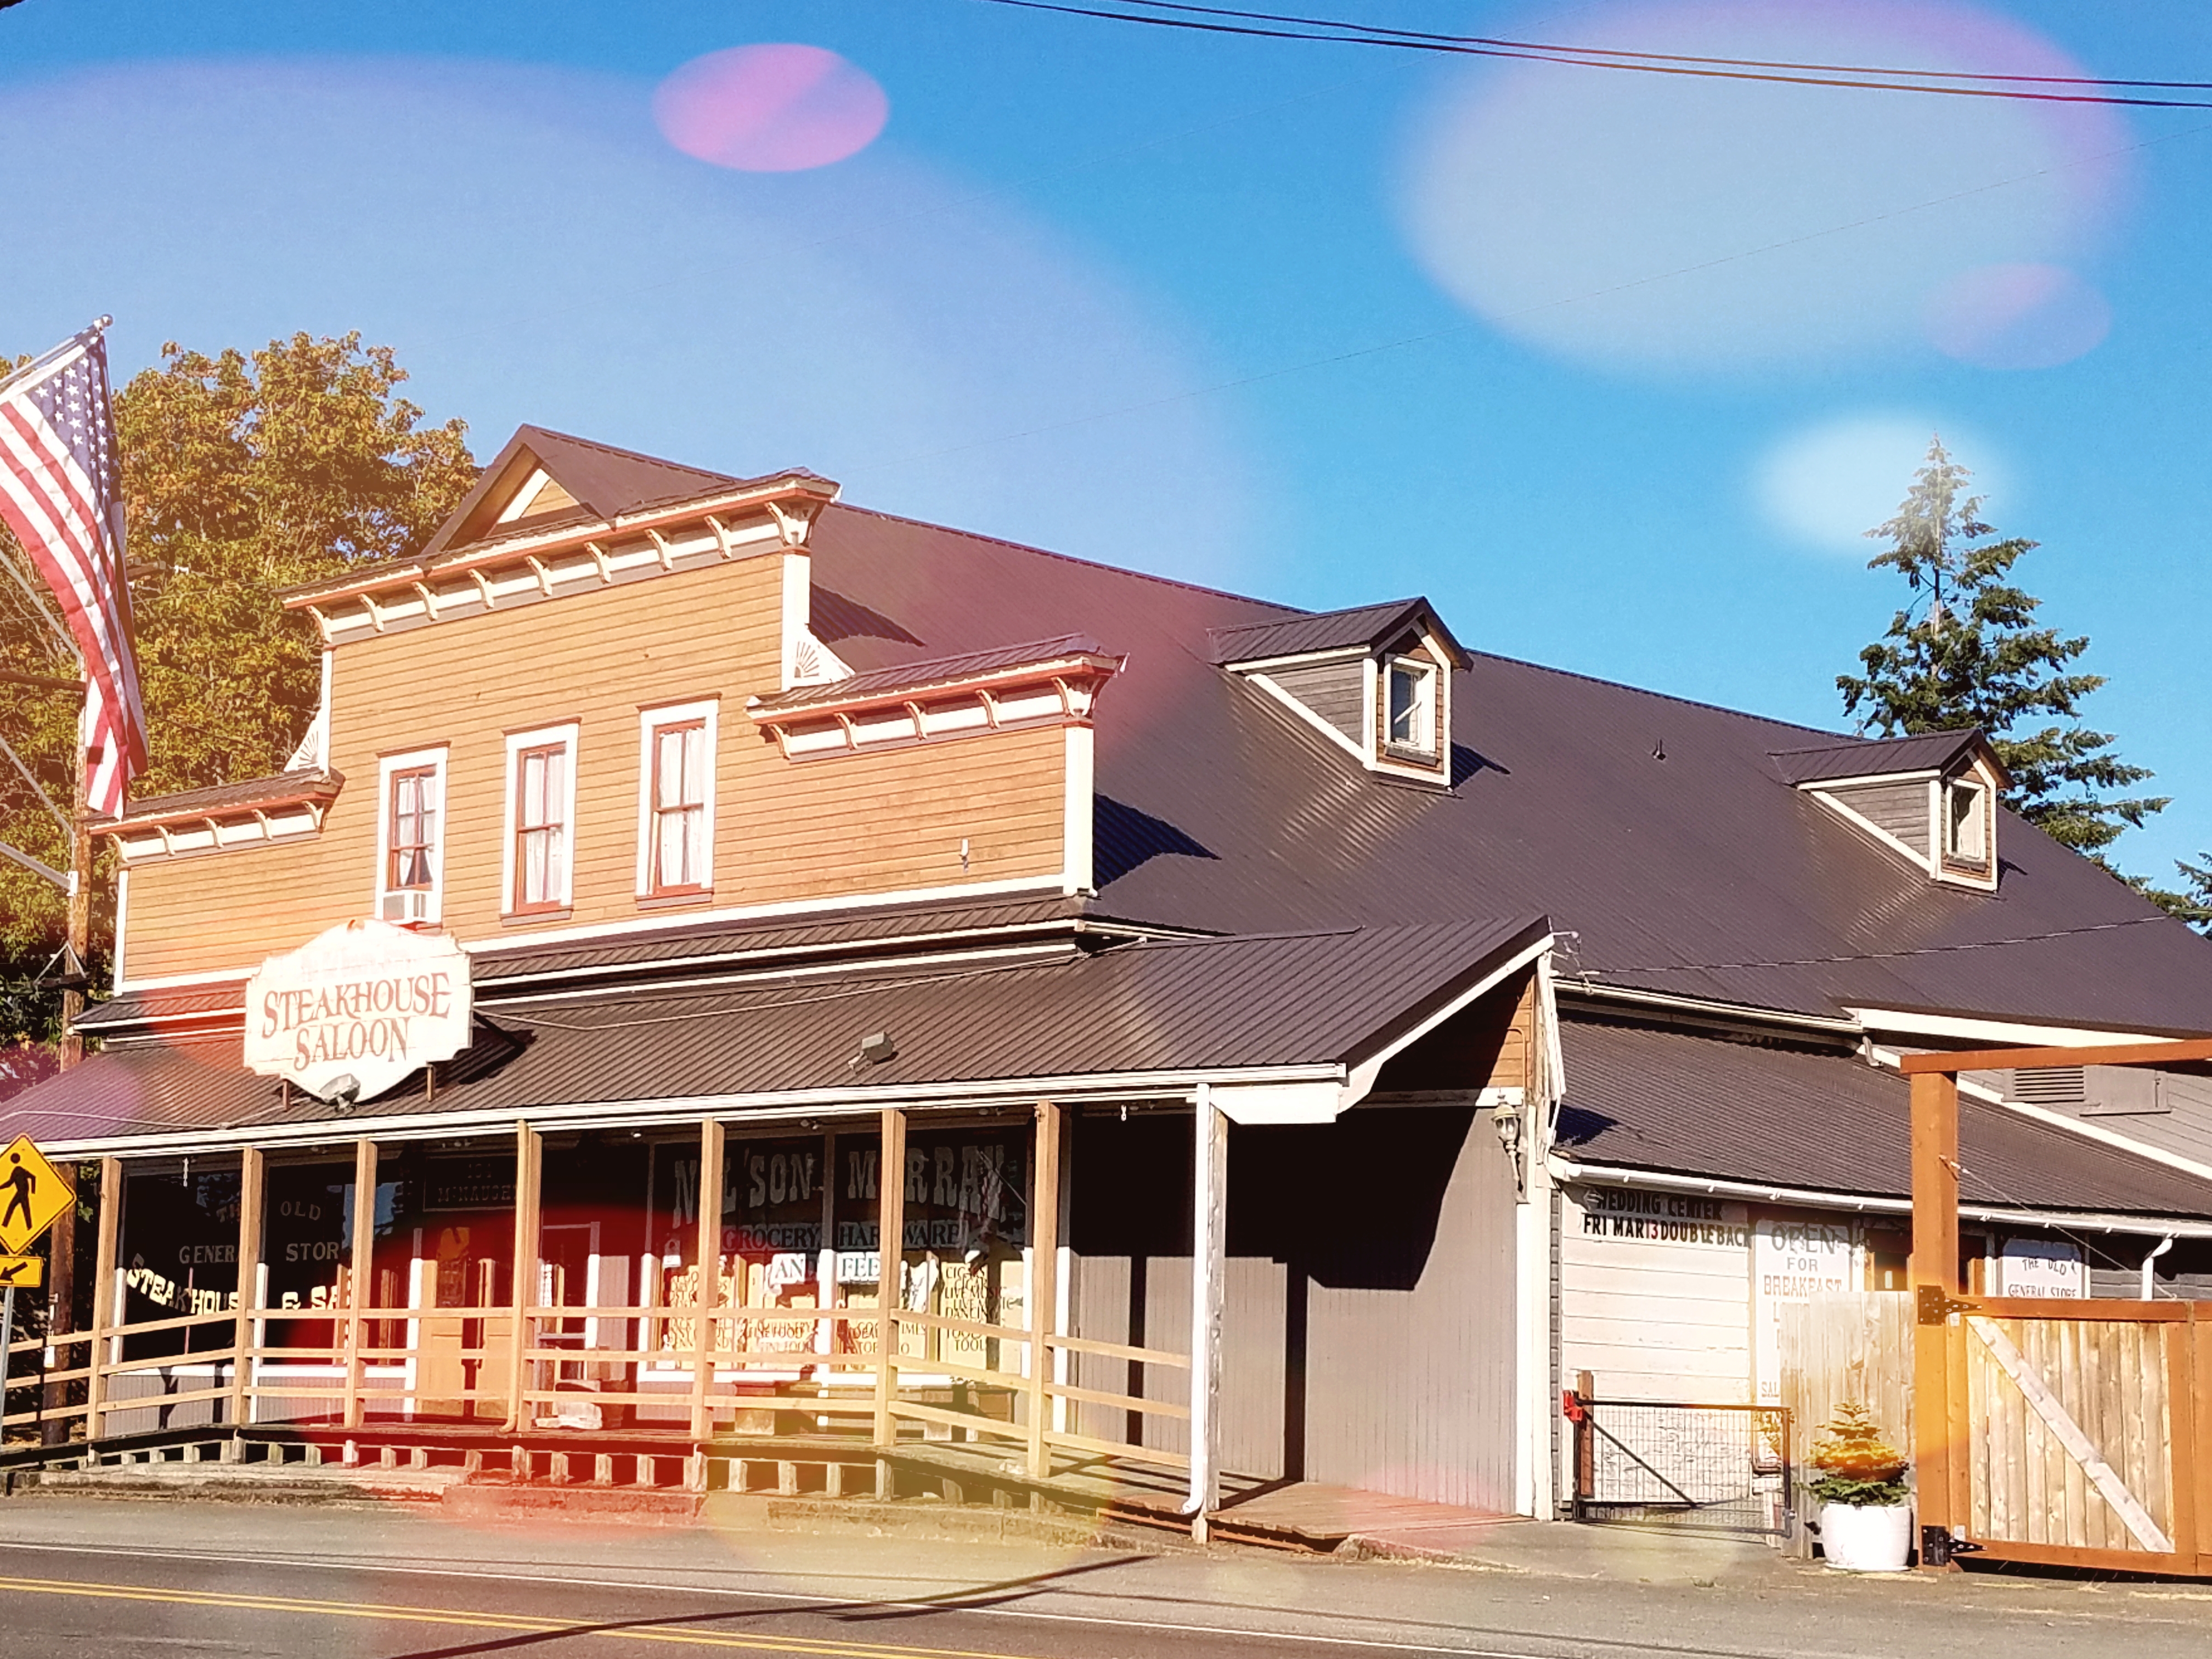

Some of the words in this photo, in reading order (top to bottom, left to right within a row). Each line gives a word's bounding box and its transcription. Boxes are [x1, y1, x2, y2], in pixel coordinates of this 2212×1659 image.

[262, 973, 452, 1039] STEAKHOUSE
[294, 1017, 410, 1071] SALOON
[848, 1144, 1005, 1220] MRRAY
[280, 1200, 321, 1221] OLD
[1667, 1195, 1722, 1221] CENTER
[722, 1224, 821, 1250] GROCERY
[839, 1223, 959, 1248] HARWARE
[1583, 1212, 1607, 1236] FRI
[1613, 1216, 1644, 1239] MAR
[1661, 1222, 1714, 1245] DOUBLE
[1771, 1224, 1835, 1254] OPEN
[179, 1244, 238, 1265] GENER
[285, 1242, 340, 1262] STOR
[1786, 1257, 1818, 1272] FOR
[2022, 1259, 2040, 1271] THE
[775, 1258, 804, 1278] AN
[842, 1257, 880, 1278] FEE
[127, 1257, 239, 1315] STEAKHOUS
[1764, 1274, 1842, 1297] BREAKFAST
[2008, 1284, 2045, 1297] GENERAL
[2050, 1286, 2077, 1297] STORE
[1761, 1381, 1780, 1398] SAL
